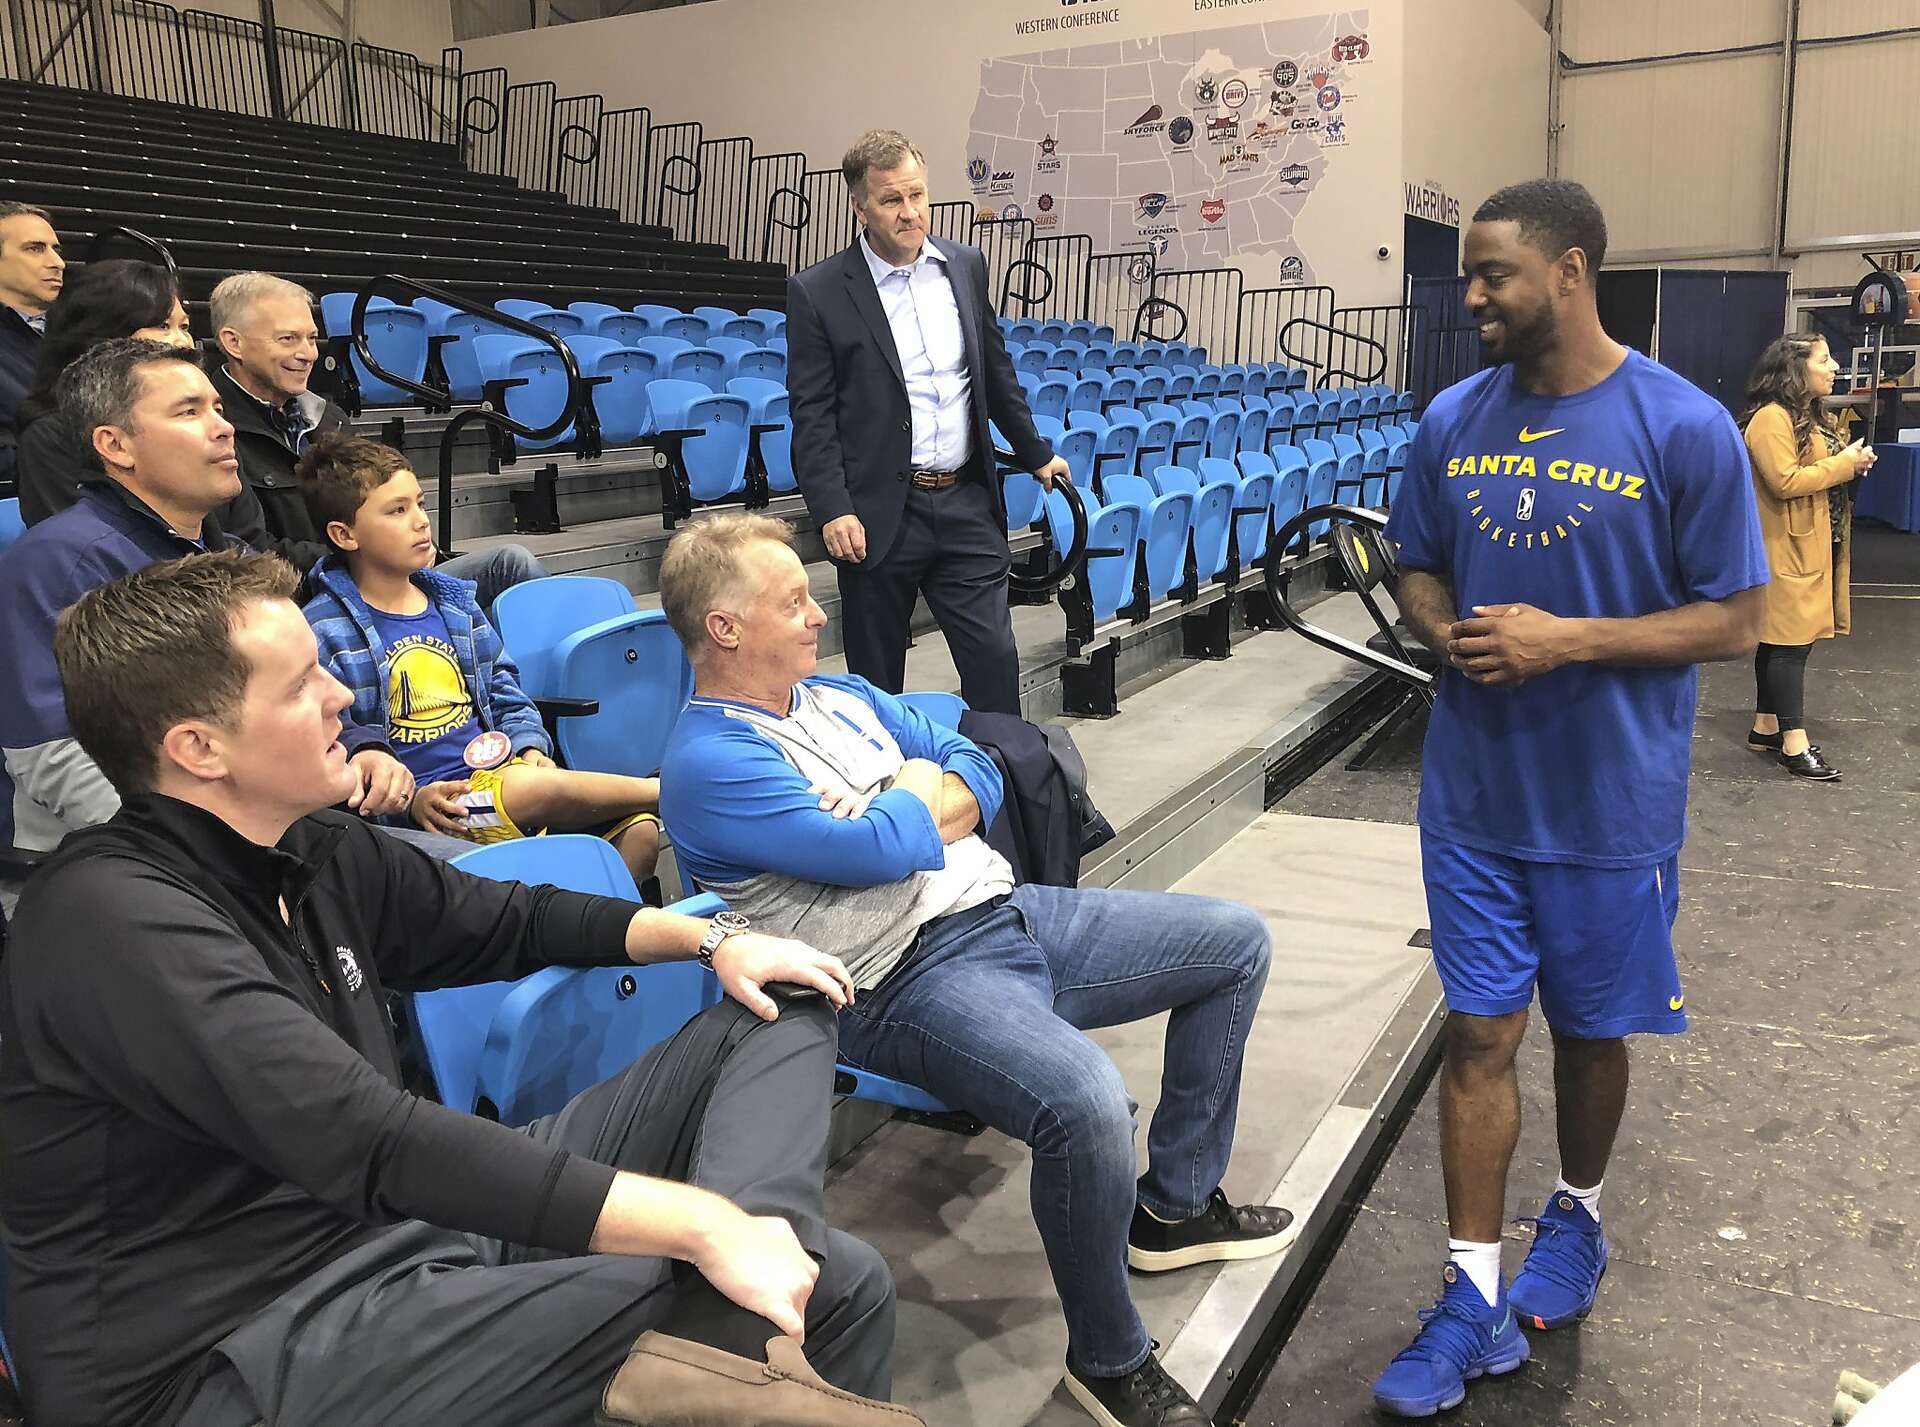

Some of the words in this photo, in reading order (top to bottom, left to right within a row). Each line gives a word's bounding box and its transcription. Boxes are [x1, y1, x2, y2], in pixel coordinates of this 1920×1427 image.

[1015, 17, 1059, 35] WESTERN
[1060, 8, 1120, 29] CONFERENCE
[1276, 73, 1295, 82] 905
[1225, 90, 1245, 100] DRIVE
[1124, 125, 1165, 136] SKYFORCE
[1325, 134, 1346, 144] COATS
[1219, 154, 1235, 165] MAD
[1241, 153, 1259, 163] ANTS
[1037, 161, 1061, 171] STARS
[1404, 182, 1460, 227] WARRIORS
[1138, 227, 1179, 236] LEGENDS
[1280, 271, 1304, 282] MAGIC
[1447, 455, 1536, 478] SANTA
[1547, 459, 1646, 500] CRUZ
[1466, 489, 1594, 549] BASKETBALL
[385, 634, 422, 663] LDEN
